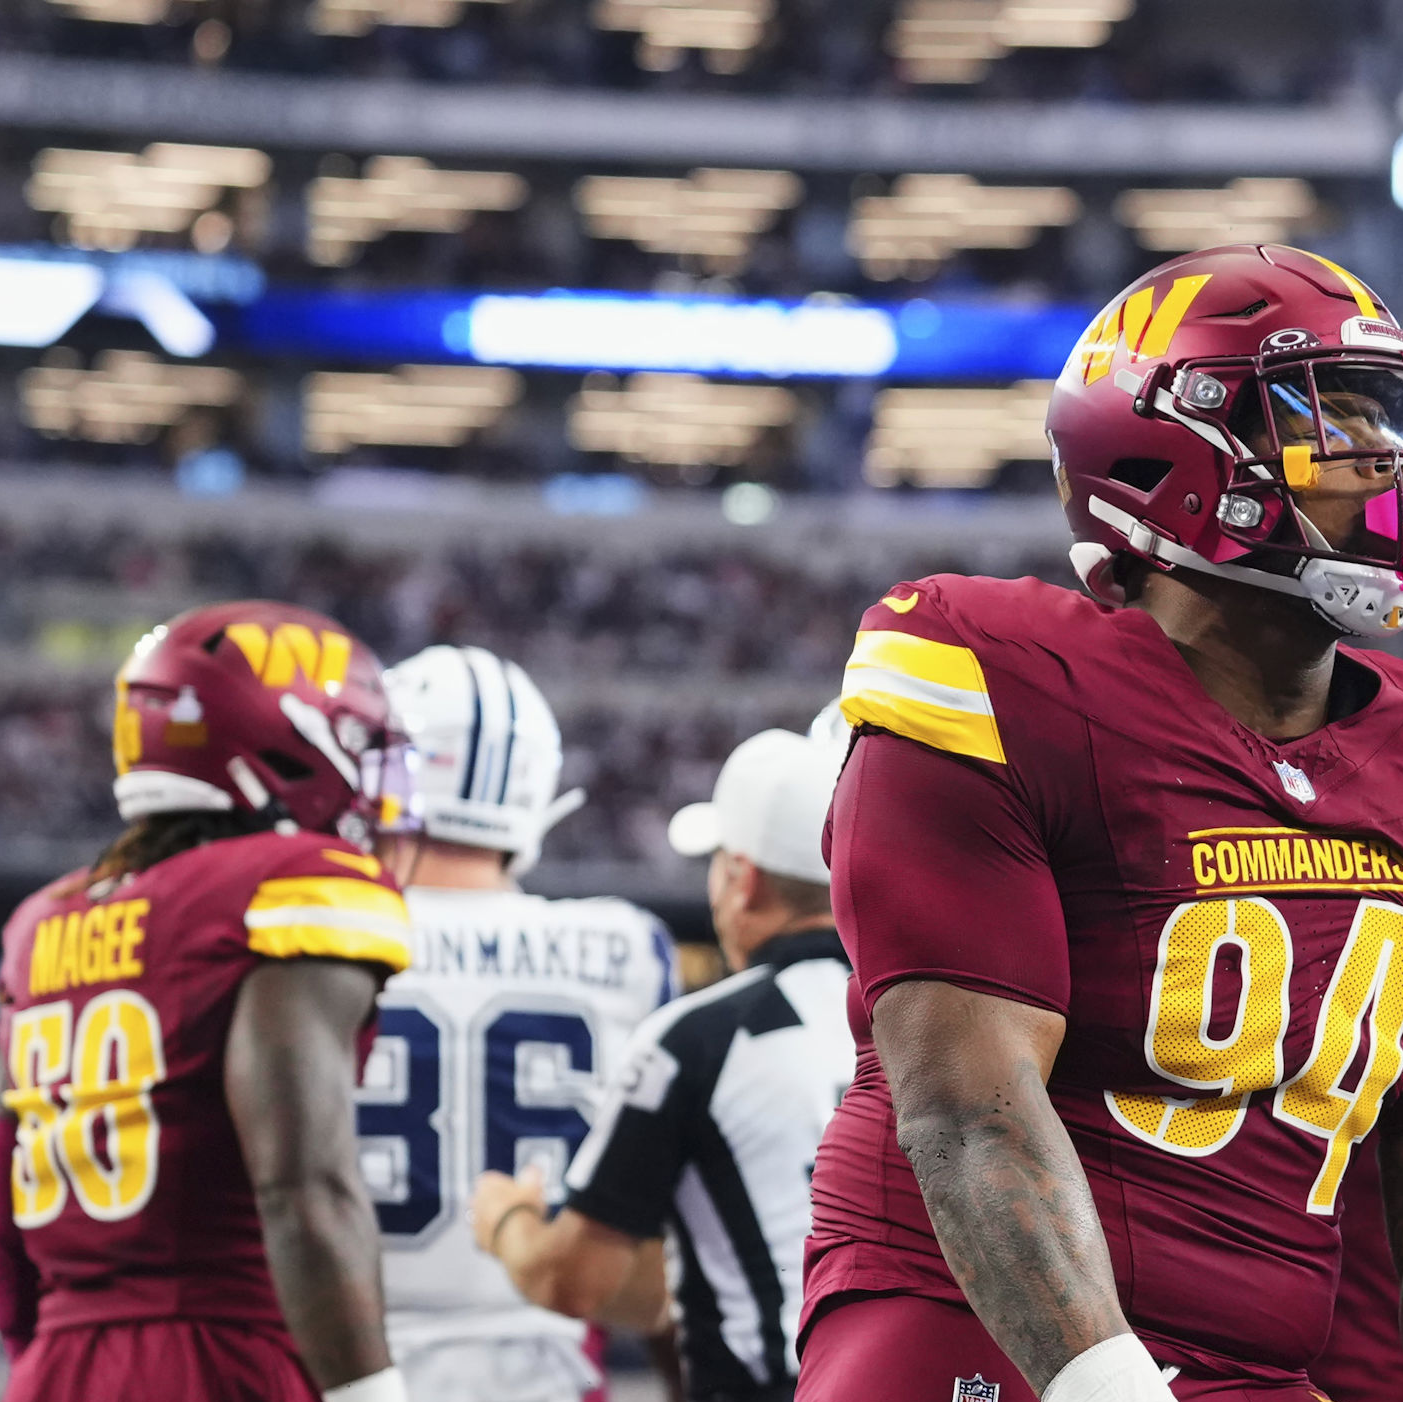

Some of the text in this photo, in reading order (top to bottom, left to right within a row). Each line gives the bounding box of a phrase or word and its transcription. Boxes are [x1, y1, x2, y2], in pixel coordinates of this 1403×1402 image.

[30, 898, 151, 995] MAGEE
[2, 988, 165, 1231] 50
[355, 987, 601, 1252] 86
